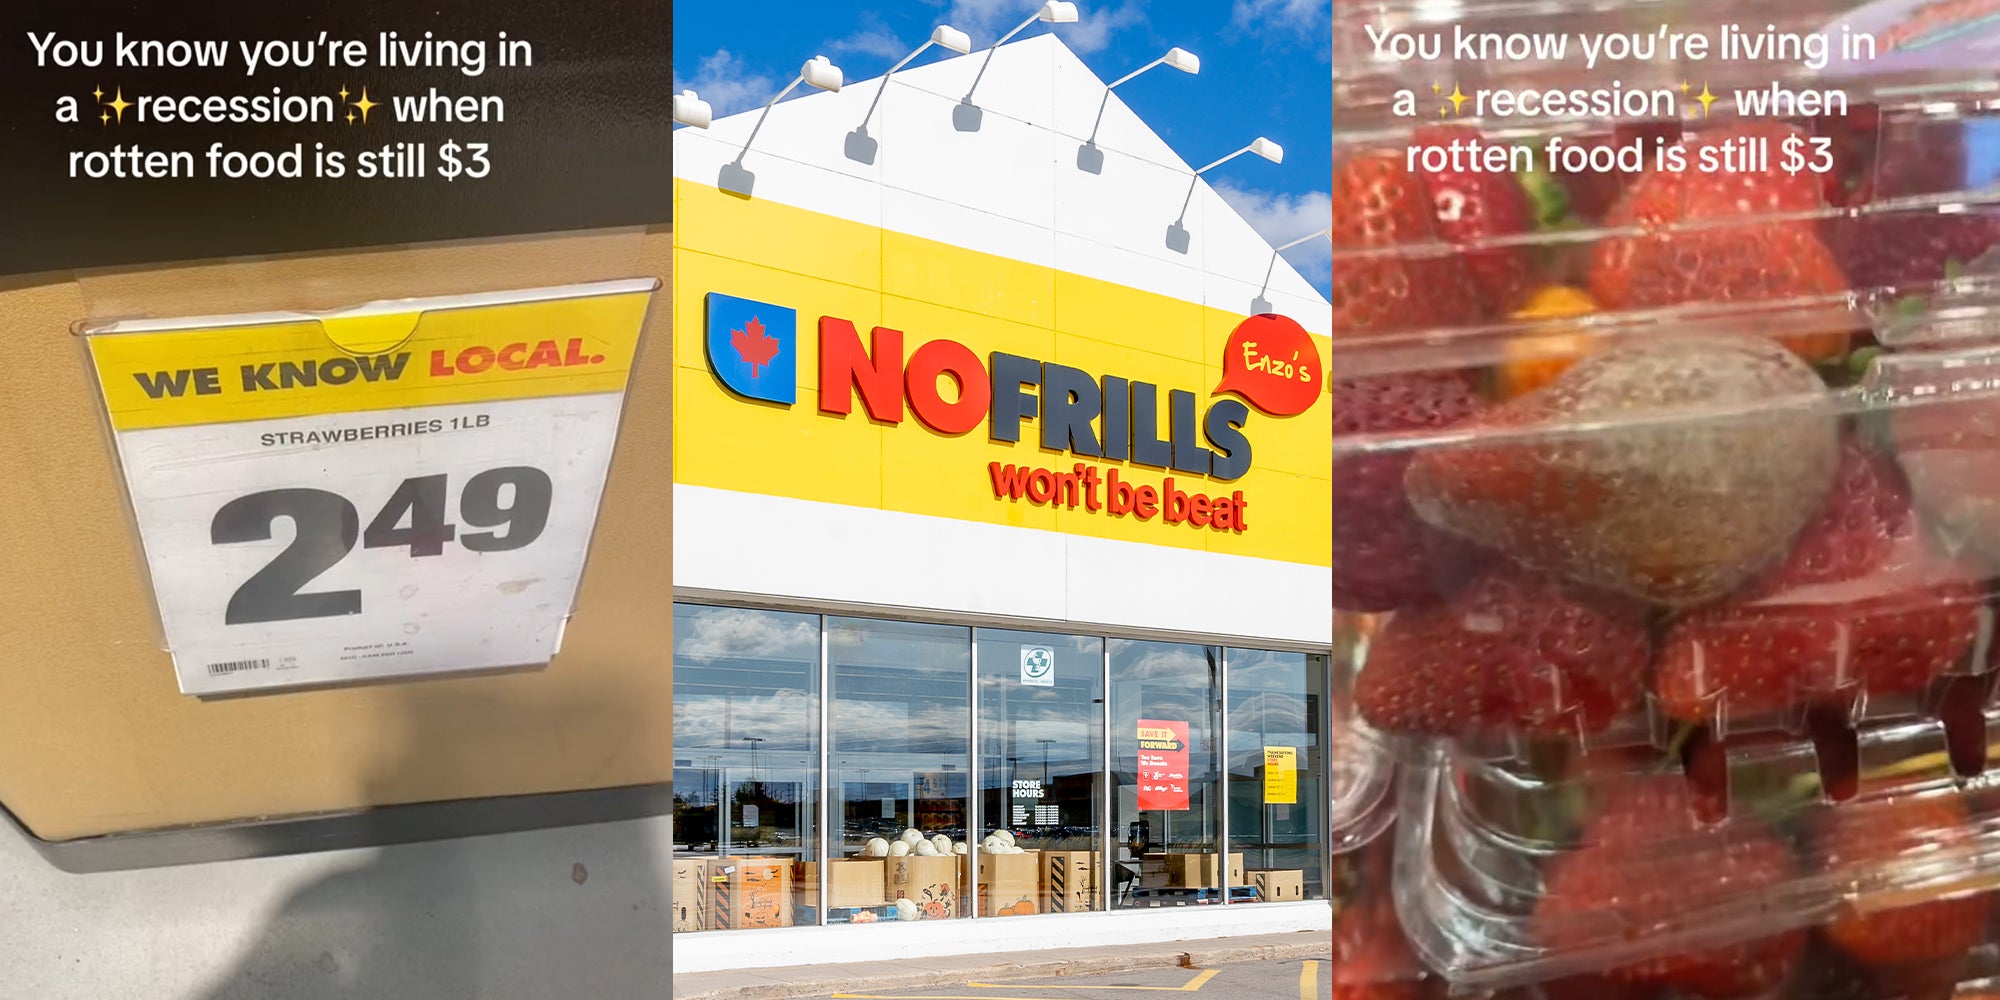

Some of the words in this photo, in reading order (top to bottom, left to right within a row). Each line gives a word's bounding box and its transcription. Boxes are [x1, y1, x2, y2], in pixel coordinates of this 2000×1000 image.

[134, 366, 220, 398] WE
[241, 352, 410, 392] KNOW
[429, 337, 607, 378] LOCAL.
[1242, 341, 1312, 383] Enzo's
[261, 419, 443, 446] STRAWBERRIES
[450, 414, 490, 430] 1LB
[989, 461, 1103, 511] won't
[1108, 468, 1159, 520] be
[1163, 477, 1248, 532] beat
[1141, 730, 1159, 738] SAVE
[1161, 730, 1168, 738] IT
[1141, 741, 1178, 749] FORWARD
[1012, 780, 1041, 789] STORE
[1012, 789, 1045, 798] HOURS
